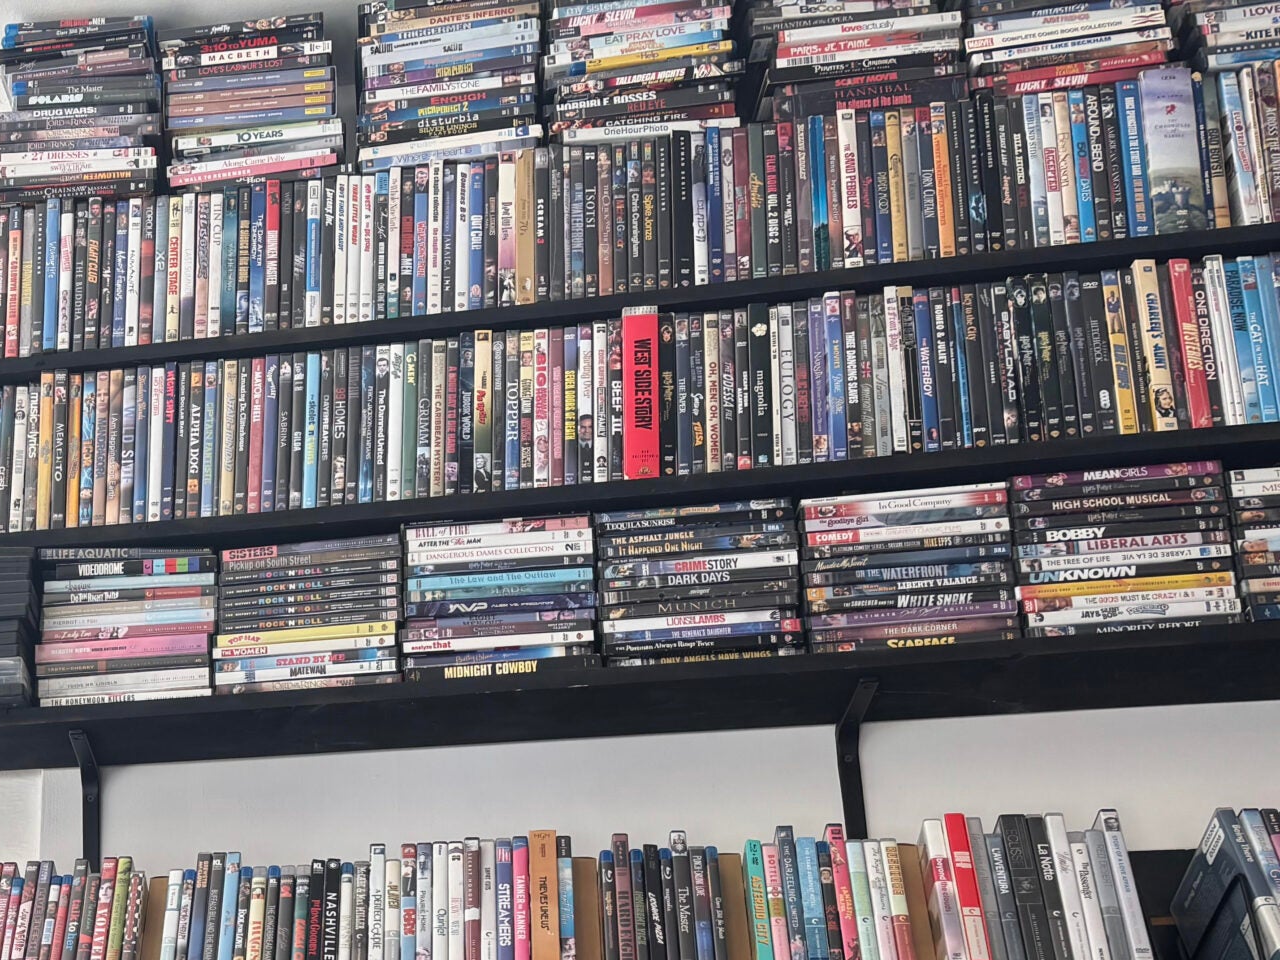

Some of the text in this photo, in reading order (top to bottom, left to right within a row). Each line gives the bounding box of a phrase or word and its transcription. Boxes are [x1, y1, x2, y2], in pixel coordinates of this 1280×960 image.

[208, 49, 270, 62] MACBETH
[834, 82, 911, 98] HANNIBAL
[29, 94, 83, 105] SOLARIS
[430, 92, 487, 105] ENOUGH
[33, 108, 55, 118] DRUG
[418, 113, 479, 128] disturbia
[236, 129, 283, 142] 10 YEARS
[31, 150, 89, 161] 27 DRESSES
[144, 204, 155, 240] TORQUE
[536, 199, 544, 236] SCREAM
[168, 237, 179, 296] CENTER STAGE
[1194, 290, 1216, 381] ONE DIRECTION
[634, 338, 652, 430] WEST SIDE STORY
[780, 348, 793, 423] EULOGY
[755, 369, 765, 416] magnolia
[189, 404, 201, 474] ALPHA DOG
[54, 423, 65, 482] MEMENTO
[1052, 492, 1171, 511] HIGH SCHOOL MUSICAL
[611, 531, 694, 545] THE ASPHALT JUNGLE
[815, 532, 853, 543] COMEDY
[1046, 527, 1105, 542] BOBBY
[1086, 533, 1188, 551] LIBERAL ARTS
[228, 547, 274, 559] SISTERS
[426, 549, 474, 562] DANGEROUS
[502, 544, 554, 557] COLLECTION
[78, 562, 124, 576] VIDEODROME
[229, 559, 255, 571] Pickup
[267, 557, 290, 568] South
[668, 570, 730, 586] DARK DAYS
[1029, 566, 1137, 583] UNKNOWN
[658, 600, 736, 613] MUNICH
[289, 665, 326, 677] MATEWAN
[444, 660, 537, 679] MIDNIGHT COWBOY
[498, 883, 511, 947] STREAMERS
